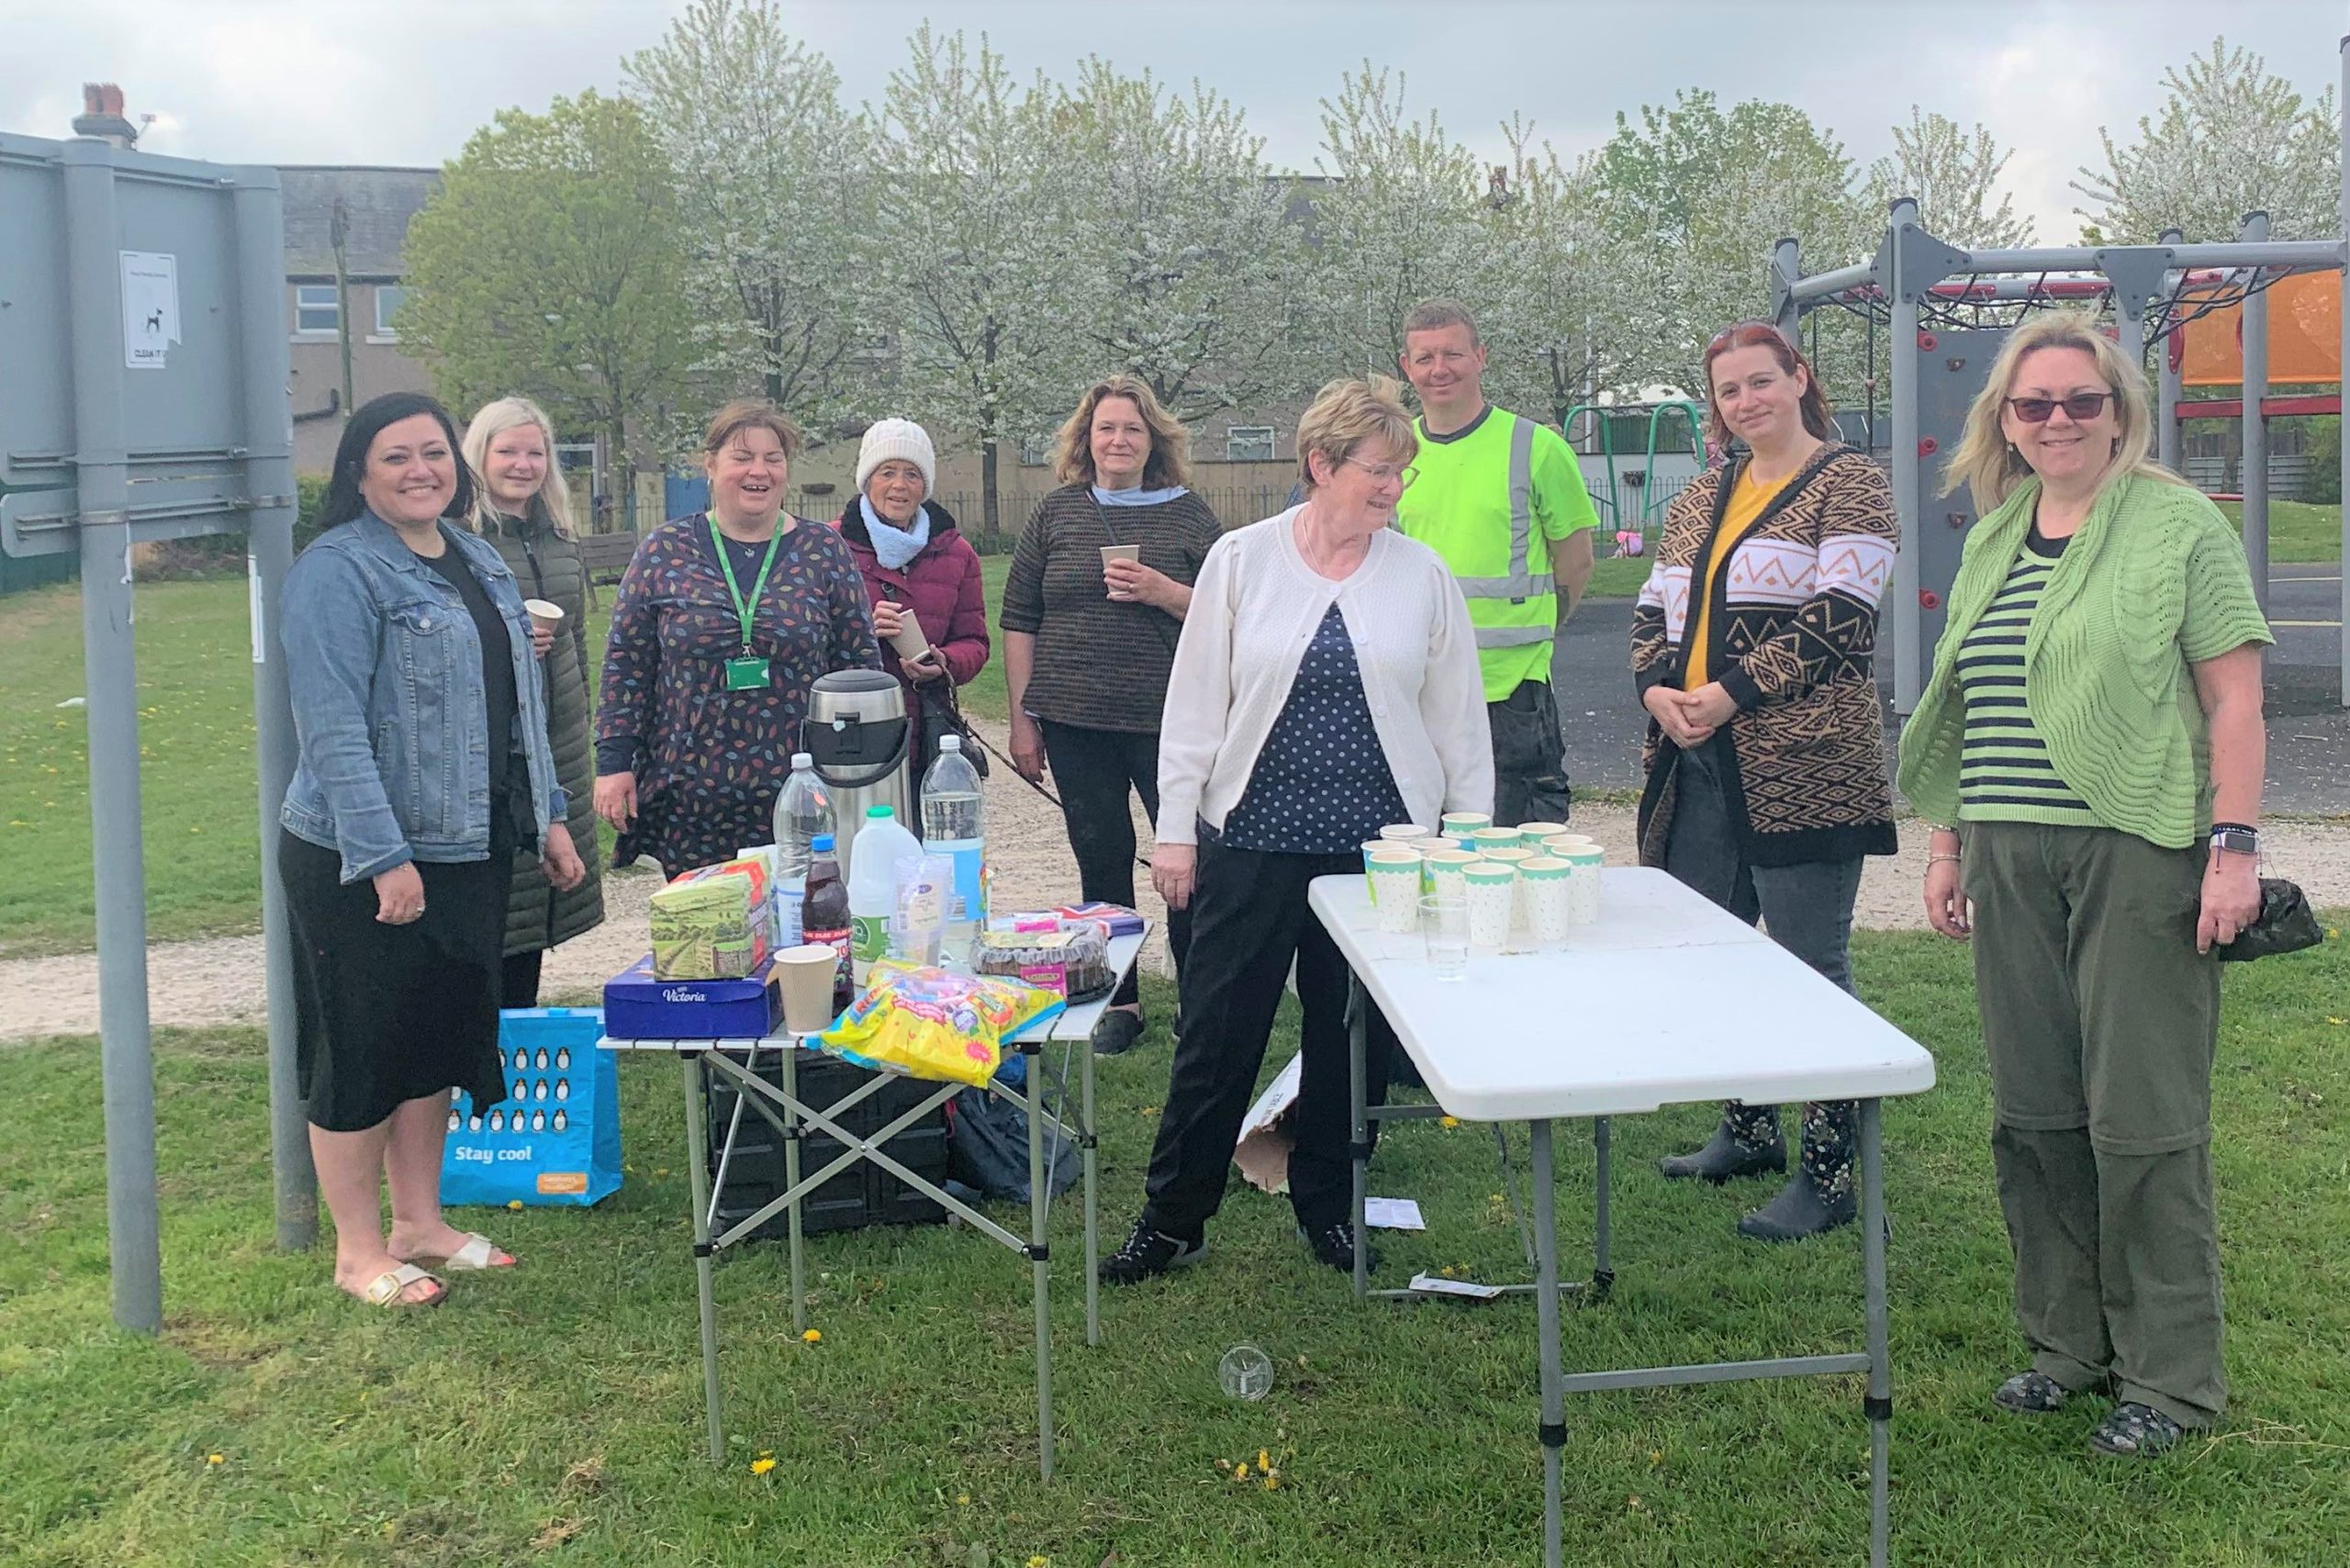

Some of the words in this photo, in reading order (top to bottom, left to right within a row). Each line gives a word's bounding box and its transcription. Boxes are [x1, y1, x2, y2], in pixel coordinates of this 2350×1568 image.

[662, 989, 706, 1002] Victoria
[455, 1146, 494, 1164] Stay
[498, 1145, 532, 1160] cool
